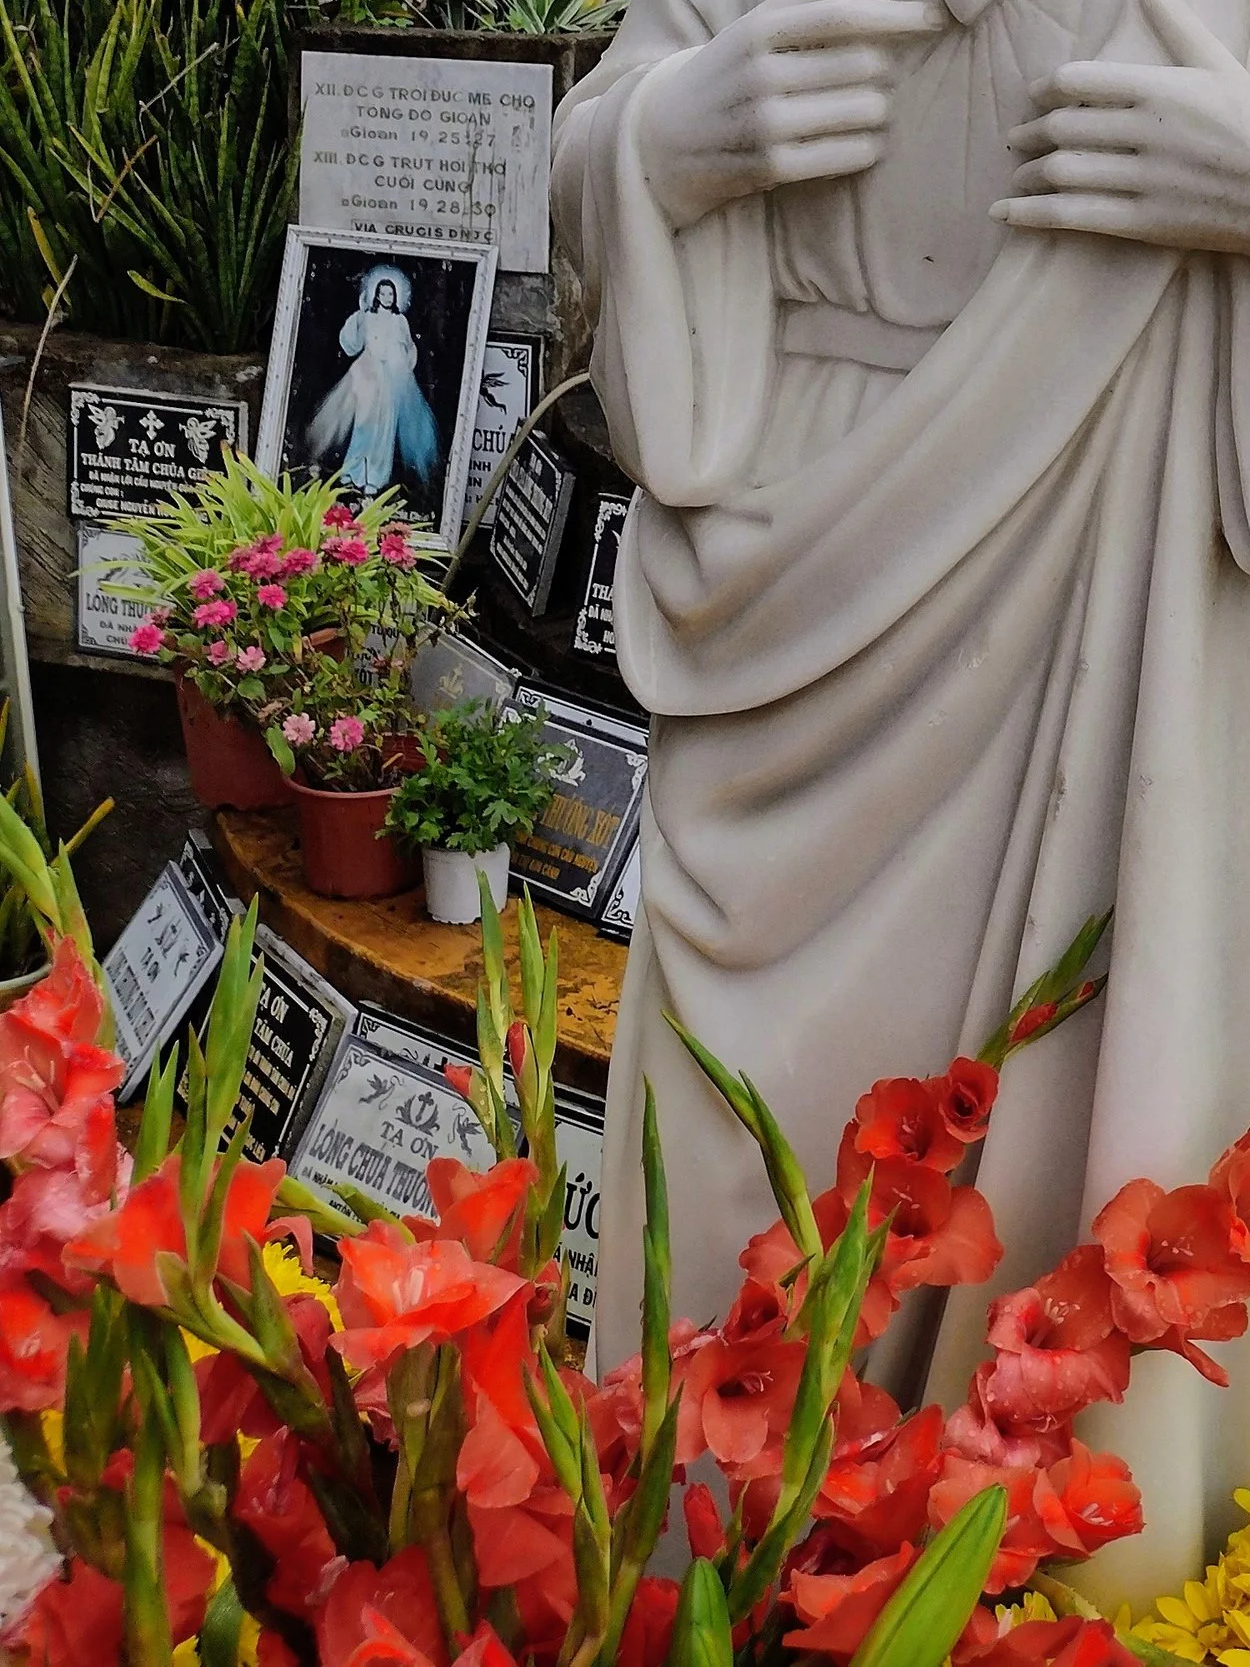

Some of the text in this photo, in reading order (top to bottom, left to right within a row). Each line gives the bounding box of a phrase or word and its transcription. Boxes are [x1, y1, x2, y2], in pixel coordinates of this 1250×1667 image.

[354, 222, 377, 233] VIA
[385, 224, 443, 238] CRUCIS
[128, 438, 176, 459] TẠ ƠN
